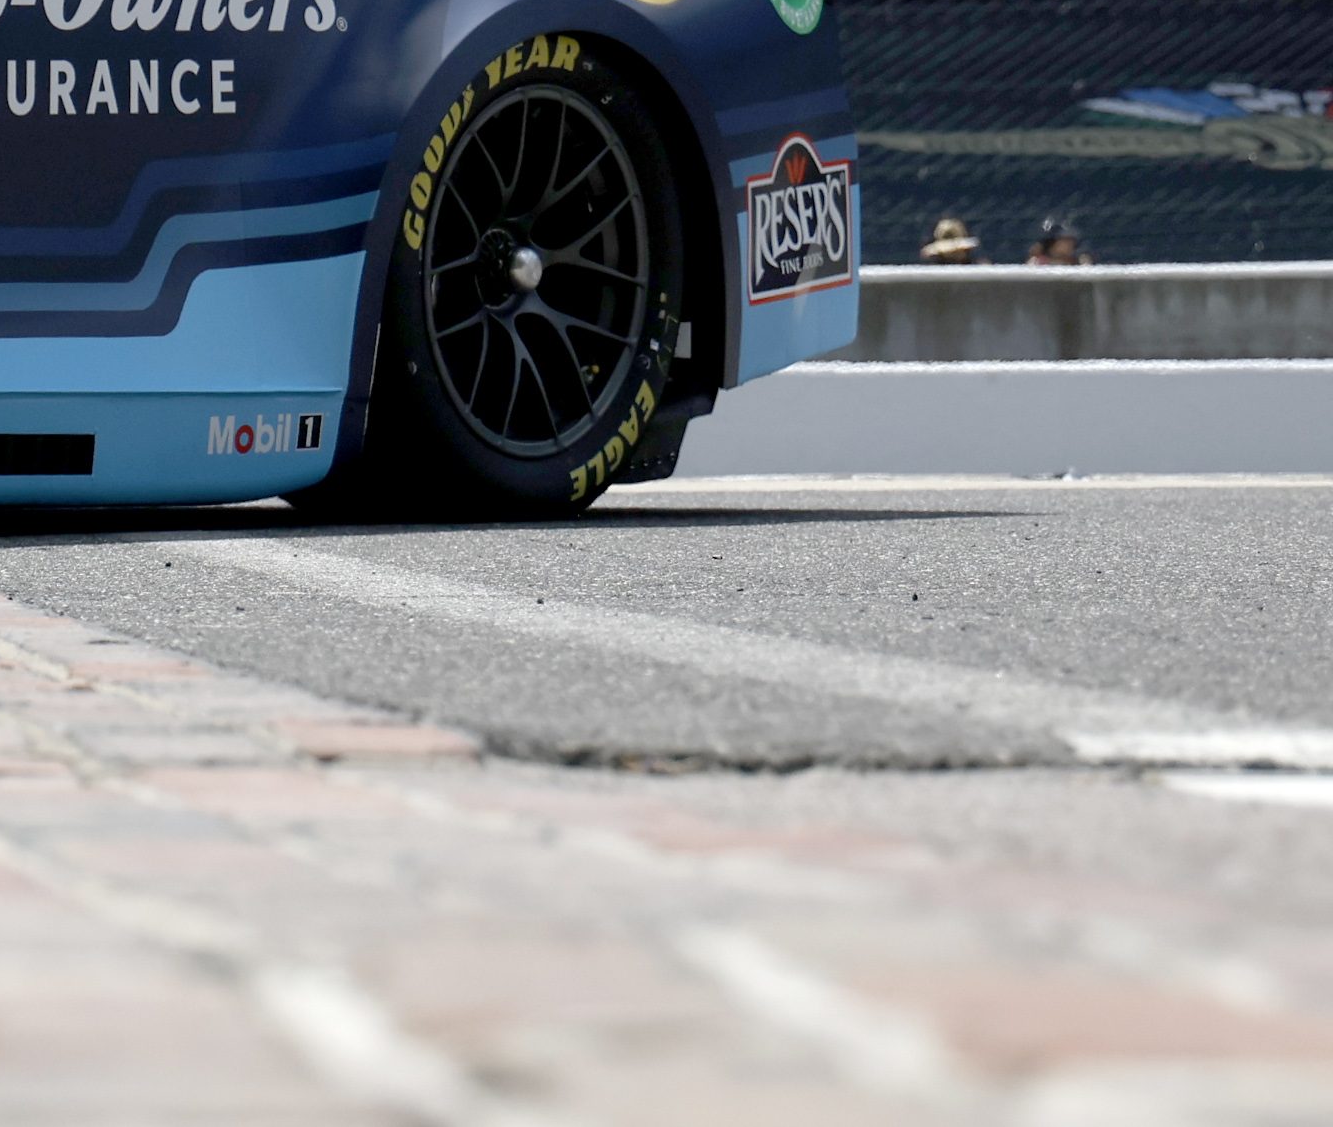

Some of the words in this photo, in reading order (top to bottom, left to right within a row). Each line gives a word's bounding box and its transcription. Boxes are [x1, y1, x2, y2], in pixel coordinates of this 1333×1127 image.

[754, 174, 846, 285] RESER'S
[780, 256, 803, 275] FINE
[207, 413, 292, 455] Mobil
[569, 378, 656, 502] EAGLE
